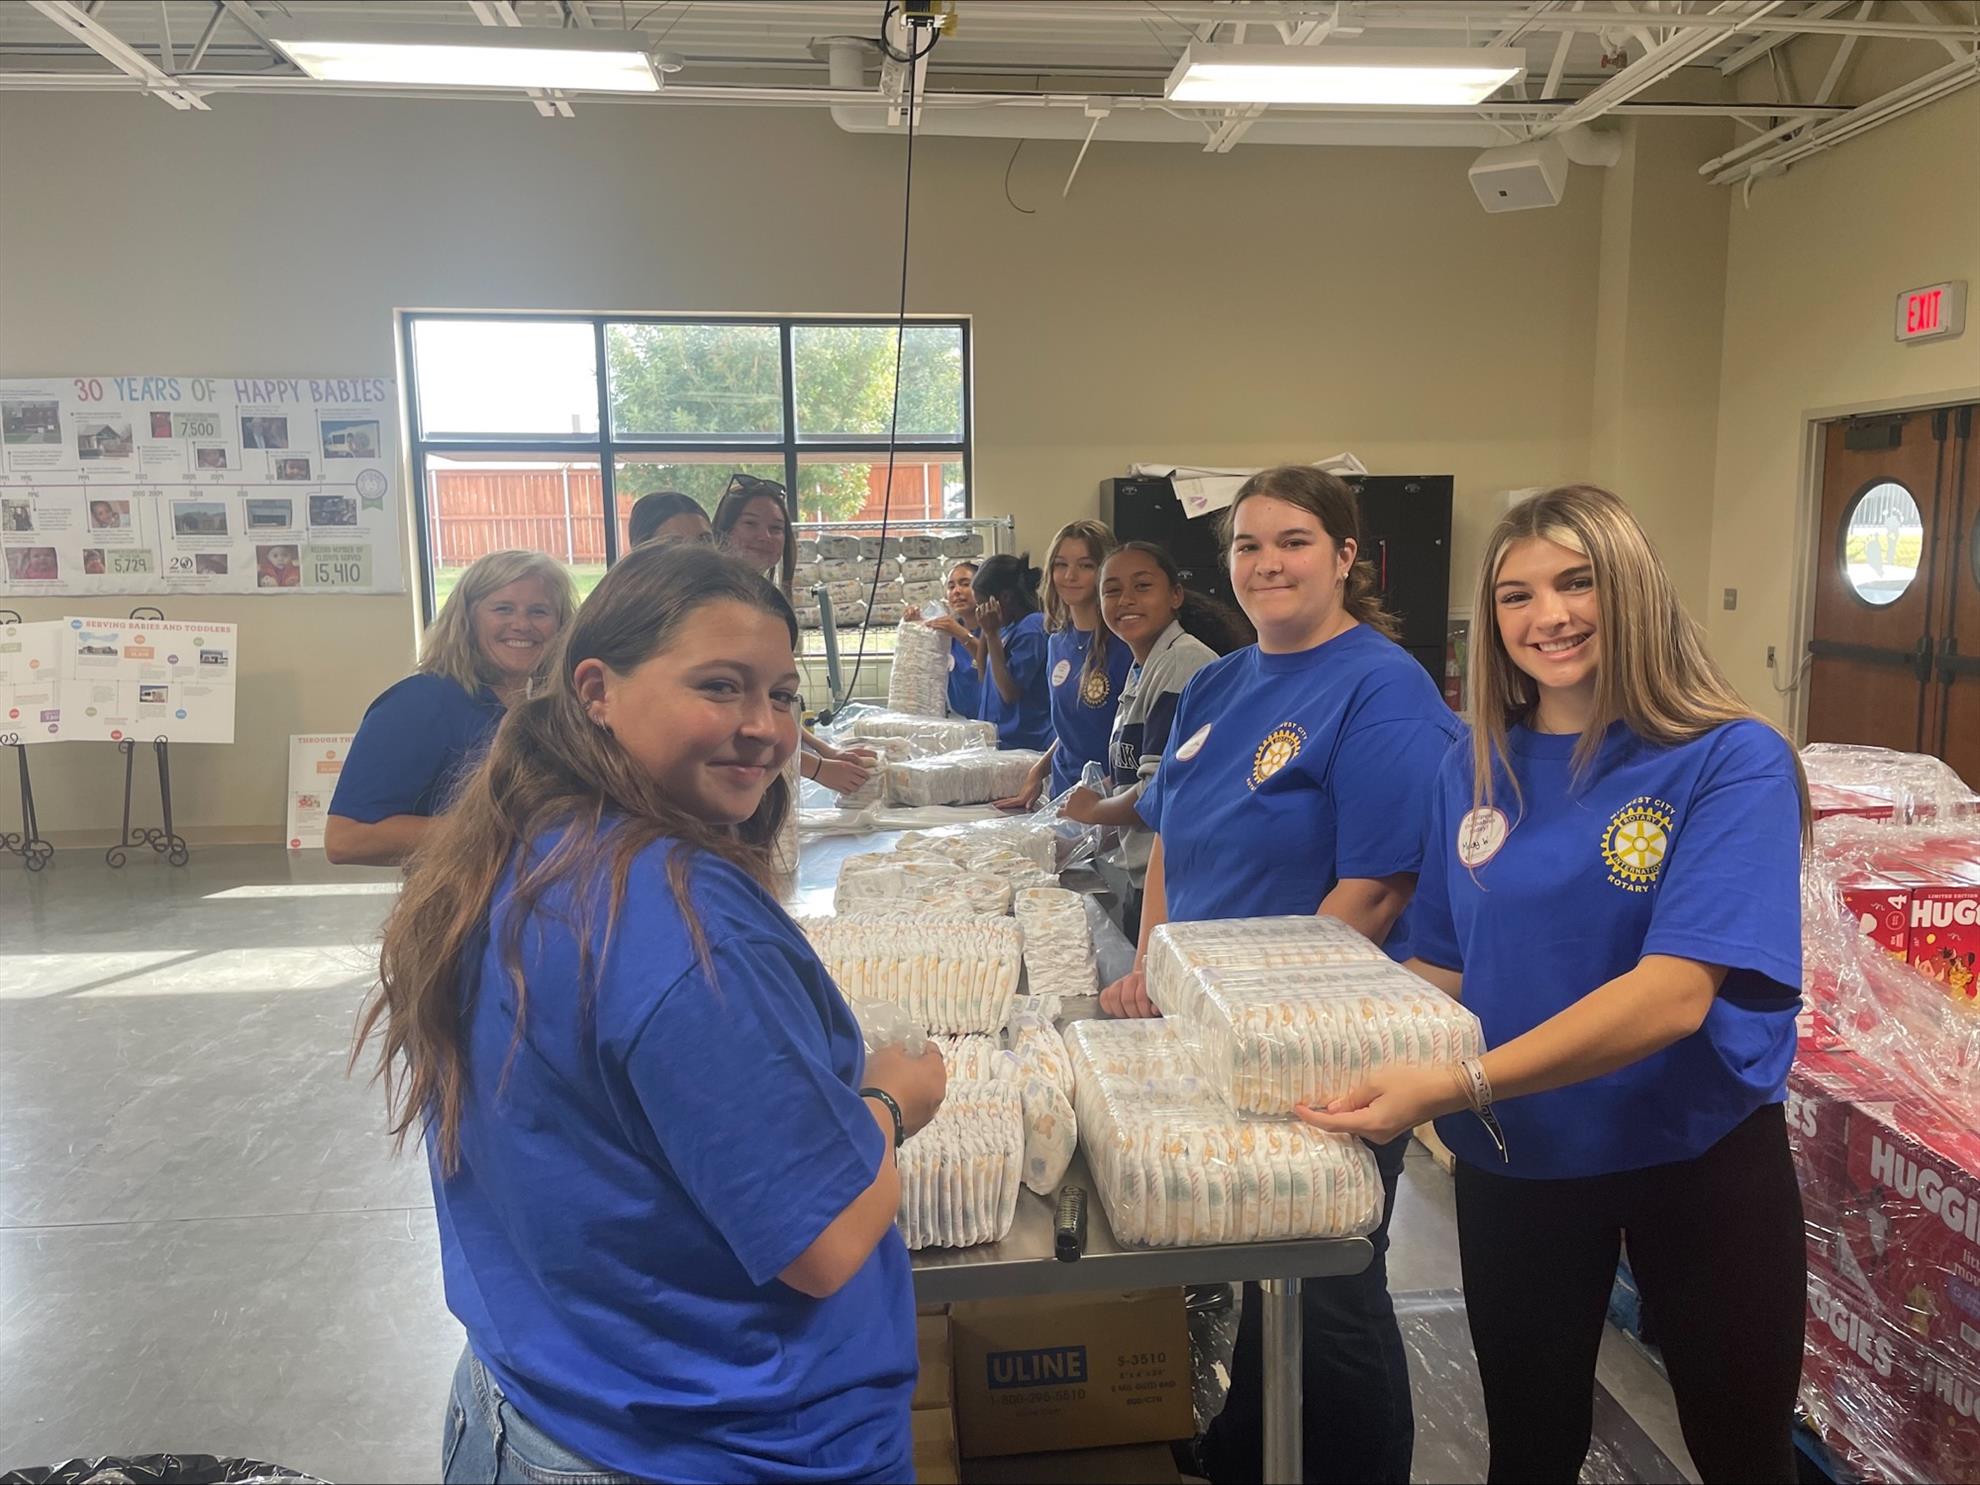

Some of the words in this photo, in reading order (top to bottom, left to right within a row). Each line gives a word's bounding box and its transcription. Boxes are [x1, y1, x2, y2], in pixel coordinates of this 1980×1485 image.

[1907, 290, 1942, 333] EXIT
[74, 378, 104, 401] 30
[113, 377, 182, 401] YEARS
[191, 379, 217, 402] OF
[233, 379, 301, 403] HAPPY
[308, 379, 386, 403] BABIES
[180, 422, 214, 438] 7,500
[114, 558, 148, 574] 5,729
[314, 563, 361, 585] 15,410
[86, 620, 127, 630] SERVING
[128, 622, 160, 631] BABIES
[162, 624, 183, 632] AND
[185, 625, 231, 634] TODDLERS
[298, 736, 338, 745] THROUGH
[340, 735, 354, 744] TH
[1654, 799, 1677, 815] CITY
[1623, 814, 1659, 824] ROTARY
[1613, 855, 1662, 875] INTERNATIO
[1607, 874, 1649, 893] ROTARY
[1910, 899, 1980, 928] HUG
[1870, 1135, 1980, 1248] HUGGI
[1807, 1276, 1895, 1378] GGIES
[993, 1352, 1082, 1382] ULINE
[1117, 1352, 1166, 1367] S-3510
